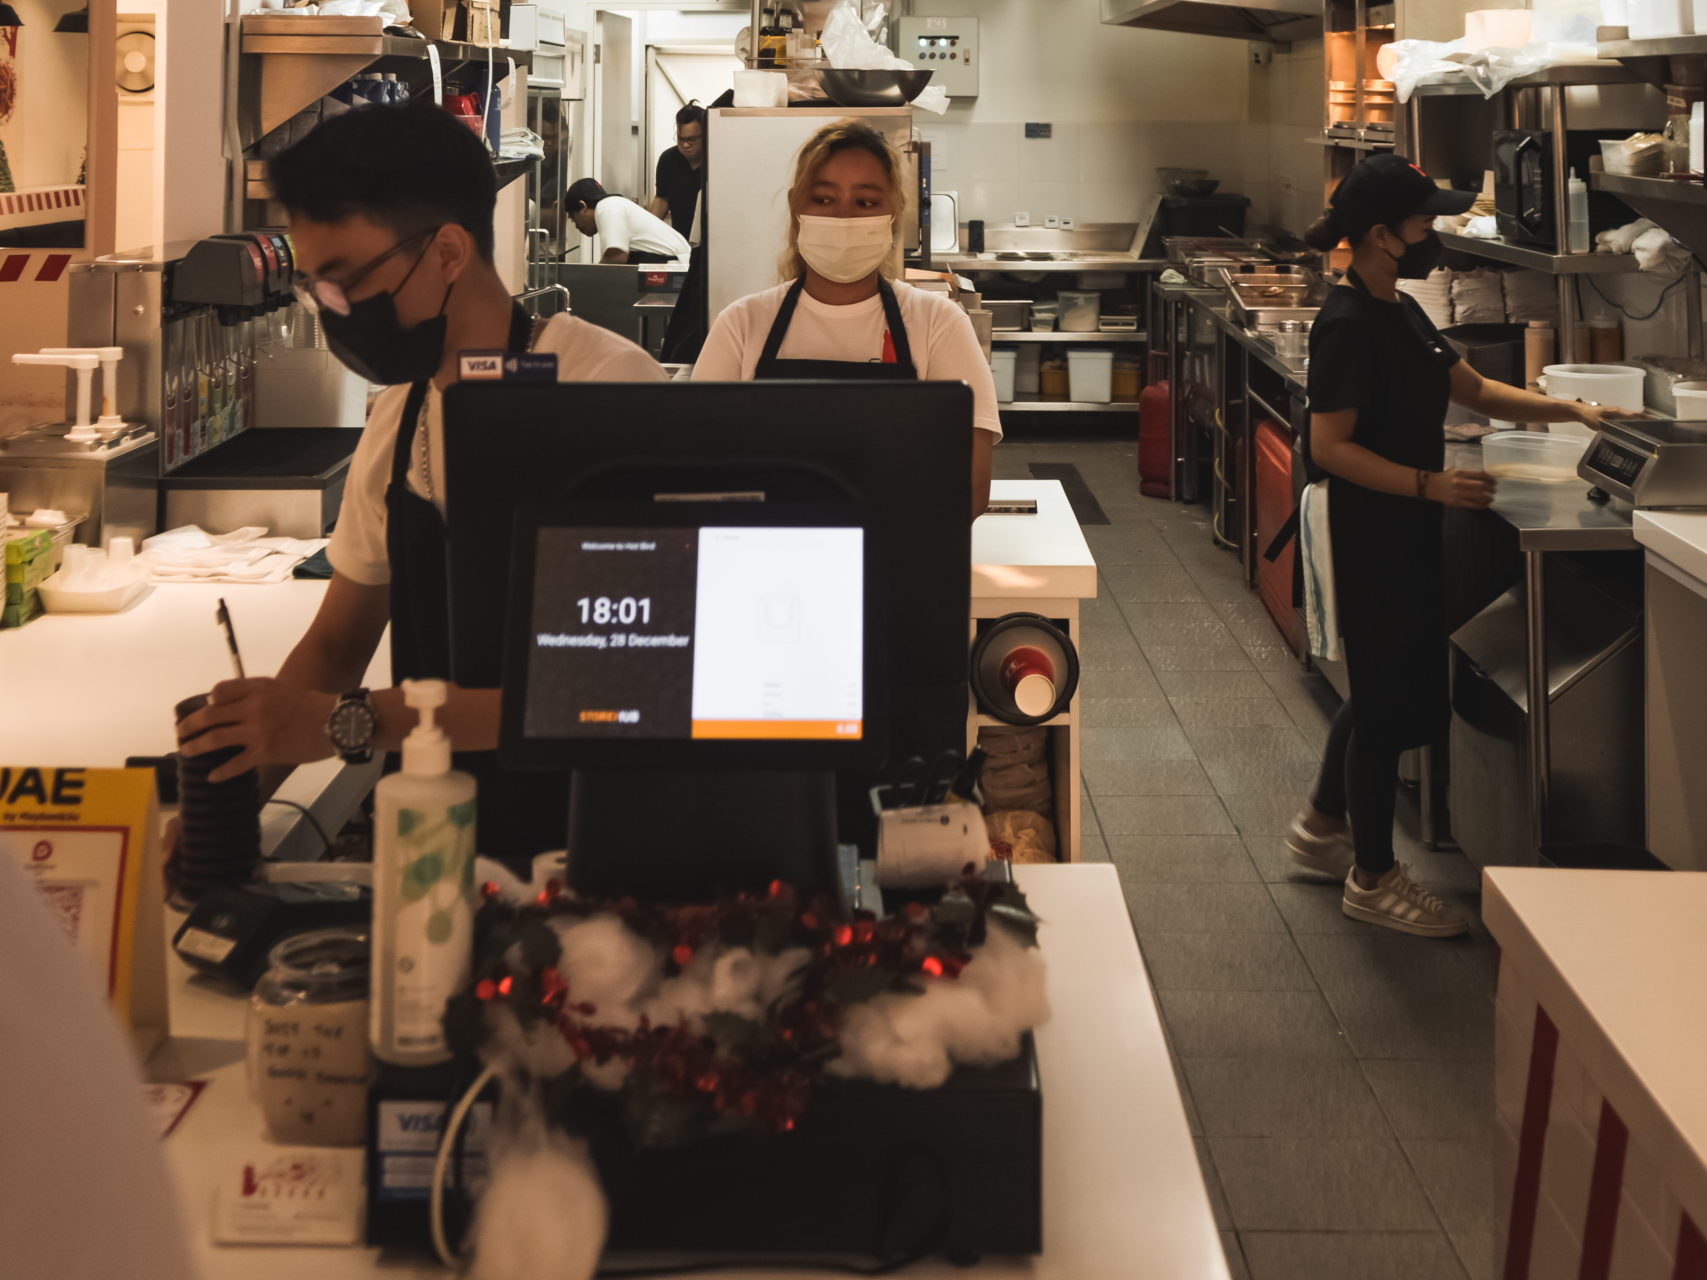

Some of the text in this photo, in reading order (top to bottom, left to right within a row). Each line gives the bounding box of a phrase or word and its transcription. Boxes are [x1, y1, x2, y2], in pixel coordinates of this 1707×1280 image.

[468, 361, 497, 371] VISA
[577, 597, 651, 625] 18:01
[537, 633, 690, 649] Wednesday, 28 December
[0, 767, 87, 806] AE
